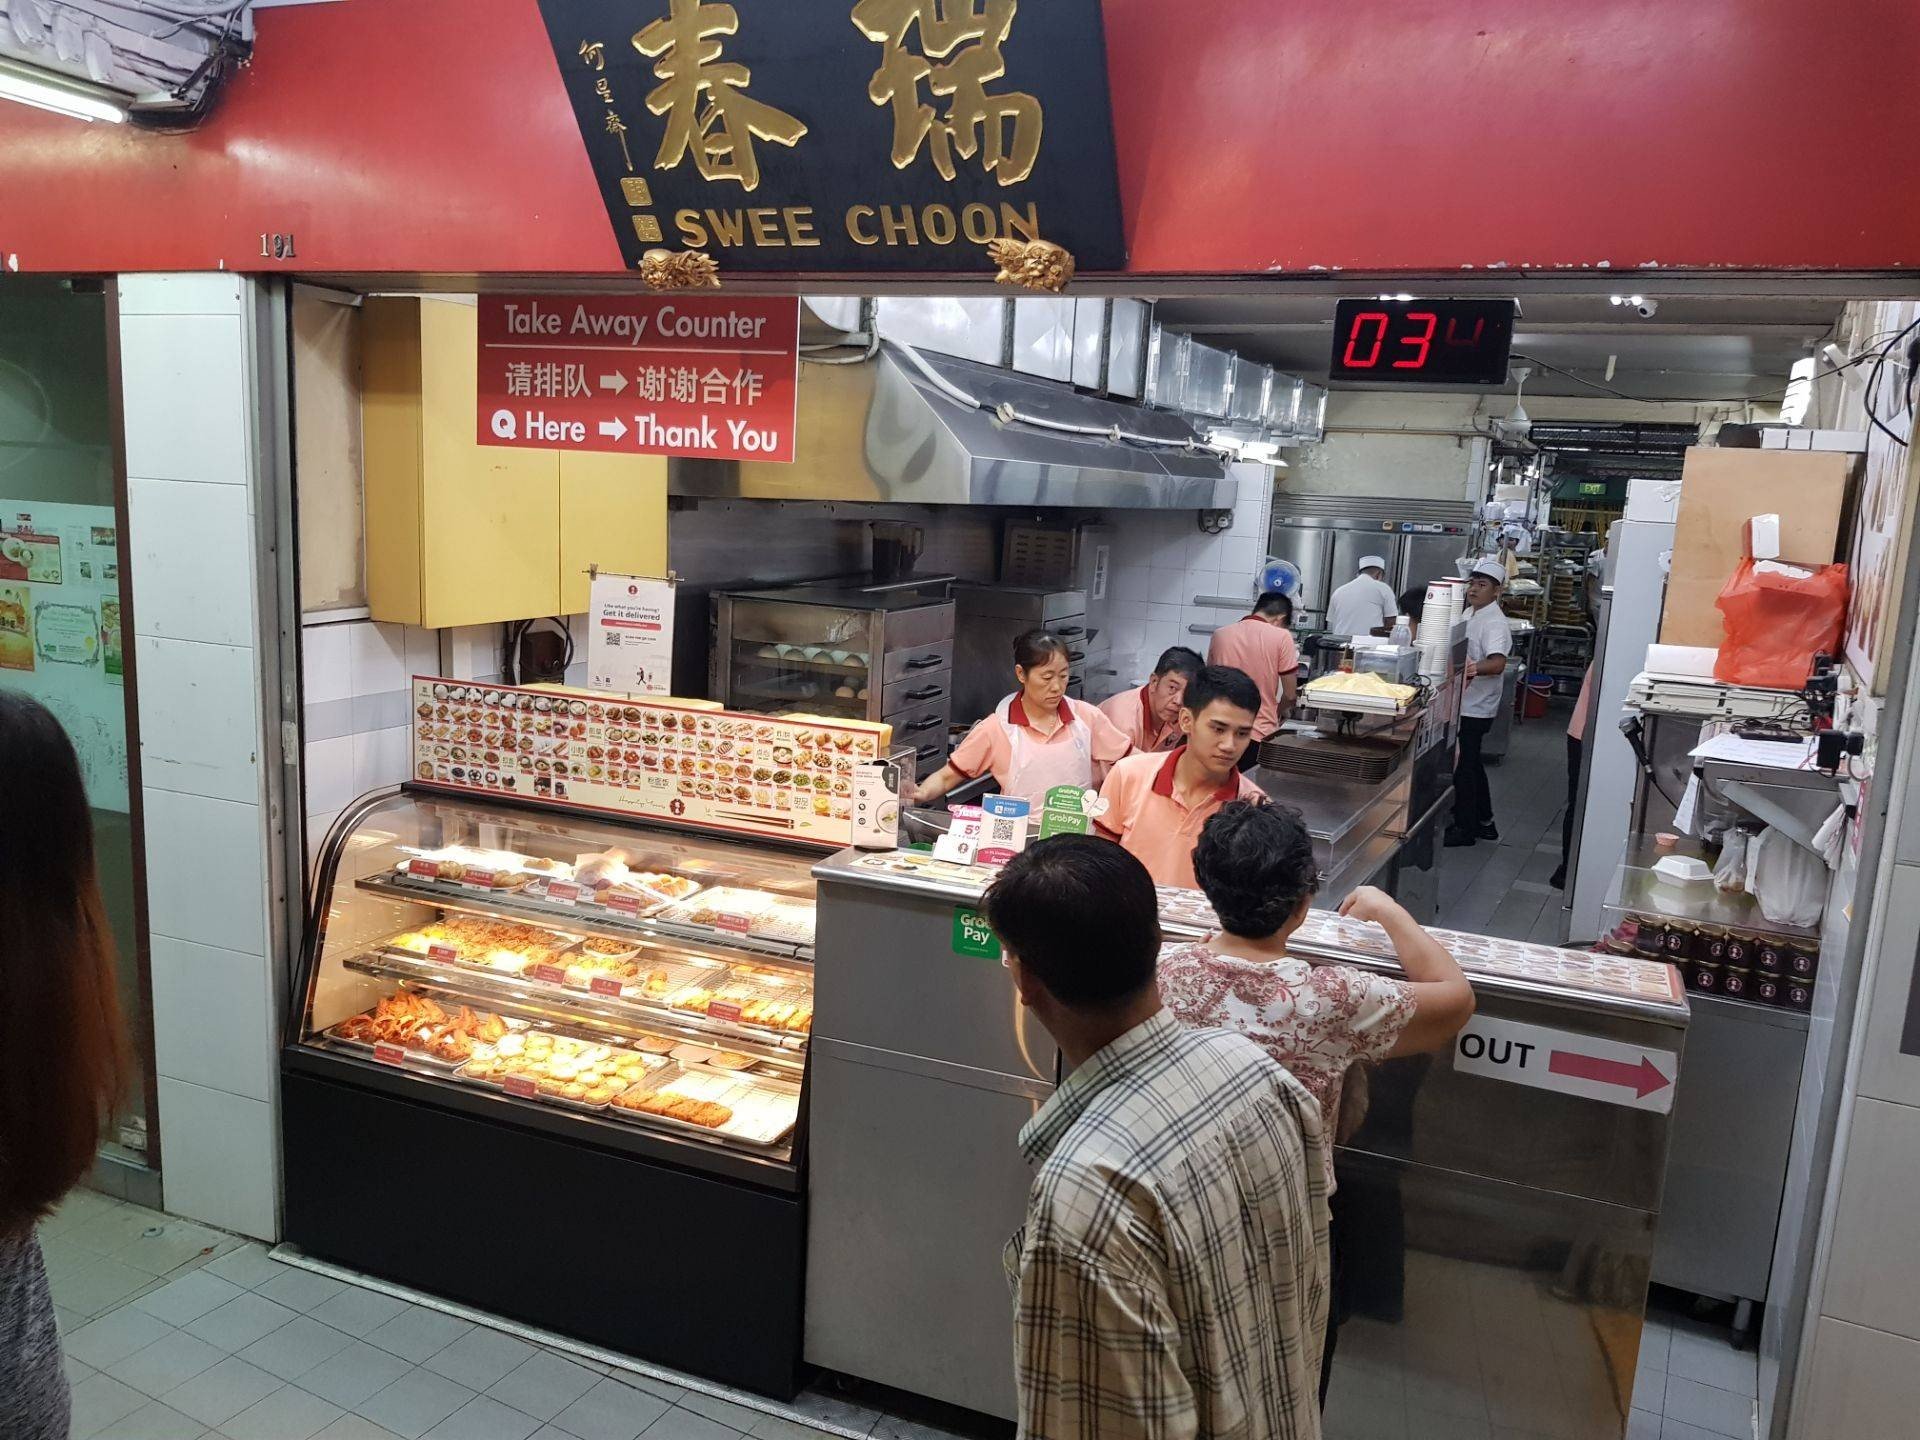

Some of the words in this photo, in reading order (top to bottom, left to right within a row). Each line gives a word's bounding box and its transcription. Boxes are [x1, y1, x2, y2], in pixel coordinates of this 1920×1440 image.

[675, 205, 822, 250] SWEE
[846, 200, 1039, 247] CHOON
[259, 232, 296, 260] 191
[504, 303, 562, 336] Take
[570, 307, 648, 345] Away
[655, 304, 767, 340] Counter
[506, 361, 592, 399] 请排队
[637, 365, 764, 406] 谢谢合作
[491, 410, 518, 440] Q
[525, 410, 586, 443] Here
[635, 413, 718, 450] Thank
[725, 418, 778, 453] You
[603, 609, 617, 617] Get
[618, 610, 624, 618] it
[625, 611, 661, 621] delivered
[964, 926, 990, 944] Pay
[1459, 1032, 1536, 1069] OUT
